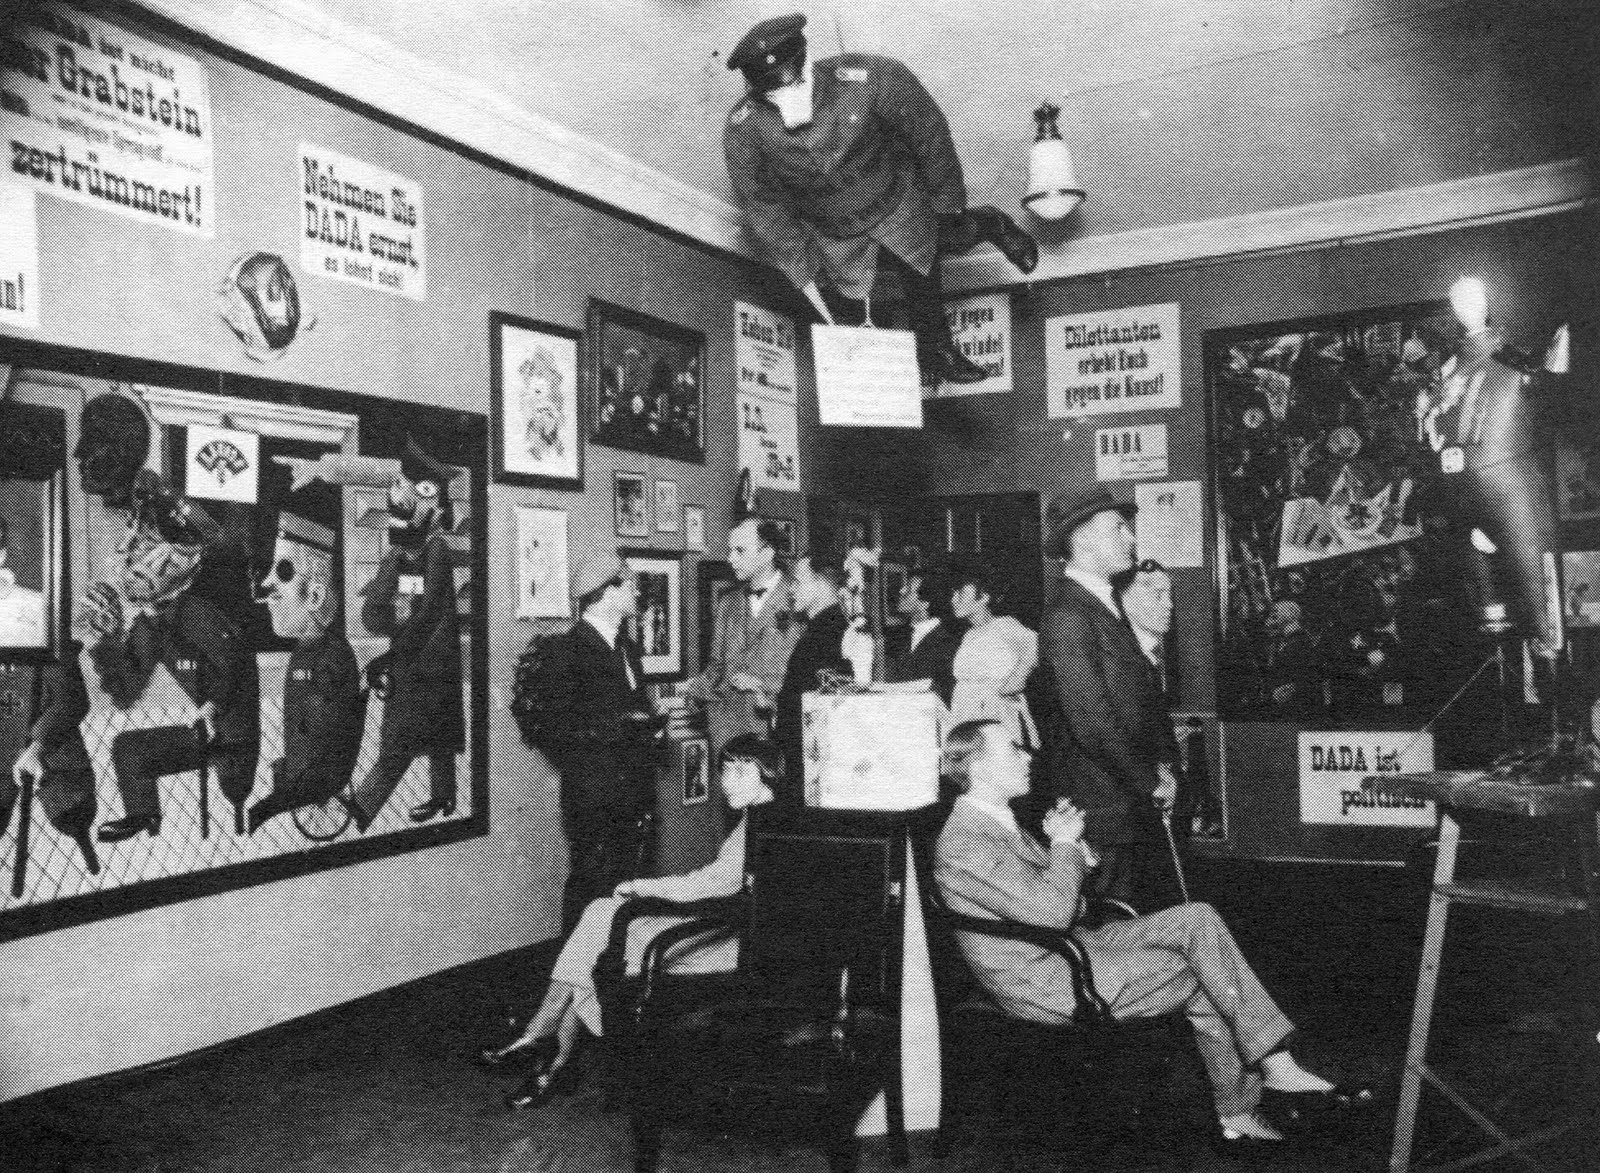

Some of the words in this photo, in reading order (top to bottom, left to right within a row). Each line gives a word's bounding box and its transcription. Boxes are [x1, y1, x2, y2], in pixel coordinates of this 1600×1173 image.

[129, 52, 175, 82] nicht
[56, 44, 202, 137] Grabstein
[10, 140, 202, 227] zertrümmert!
[303, 156, 387, 217] Nehmen
[391, 187, 417, 228] Sie
[305, 201, 364, 252] DADA
[324, 257, 338, 272] es
[1064, 320, 1162, 349] Dilettanten
[1077, 353, 1115, 376] erhebt
[1064, 385, 1100, 409] gegen
[1104, 381, 1121, 400] die
[1124, 373, 1164, 398] Kunst!
[1100, 432, 1142, 455] DADA
[1310, 745, 1368, 771] DADA
[1375, 746, 1401, 772] ist
